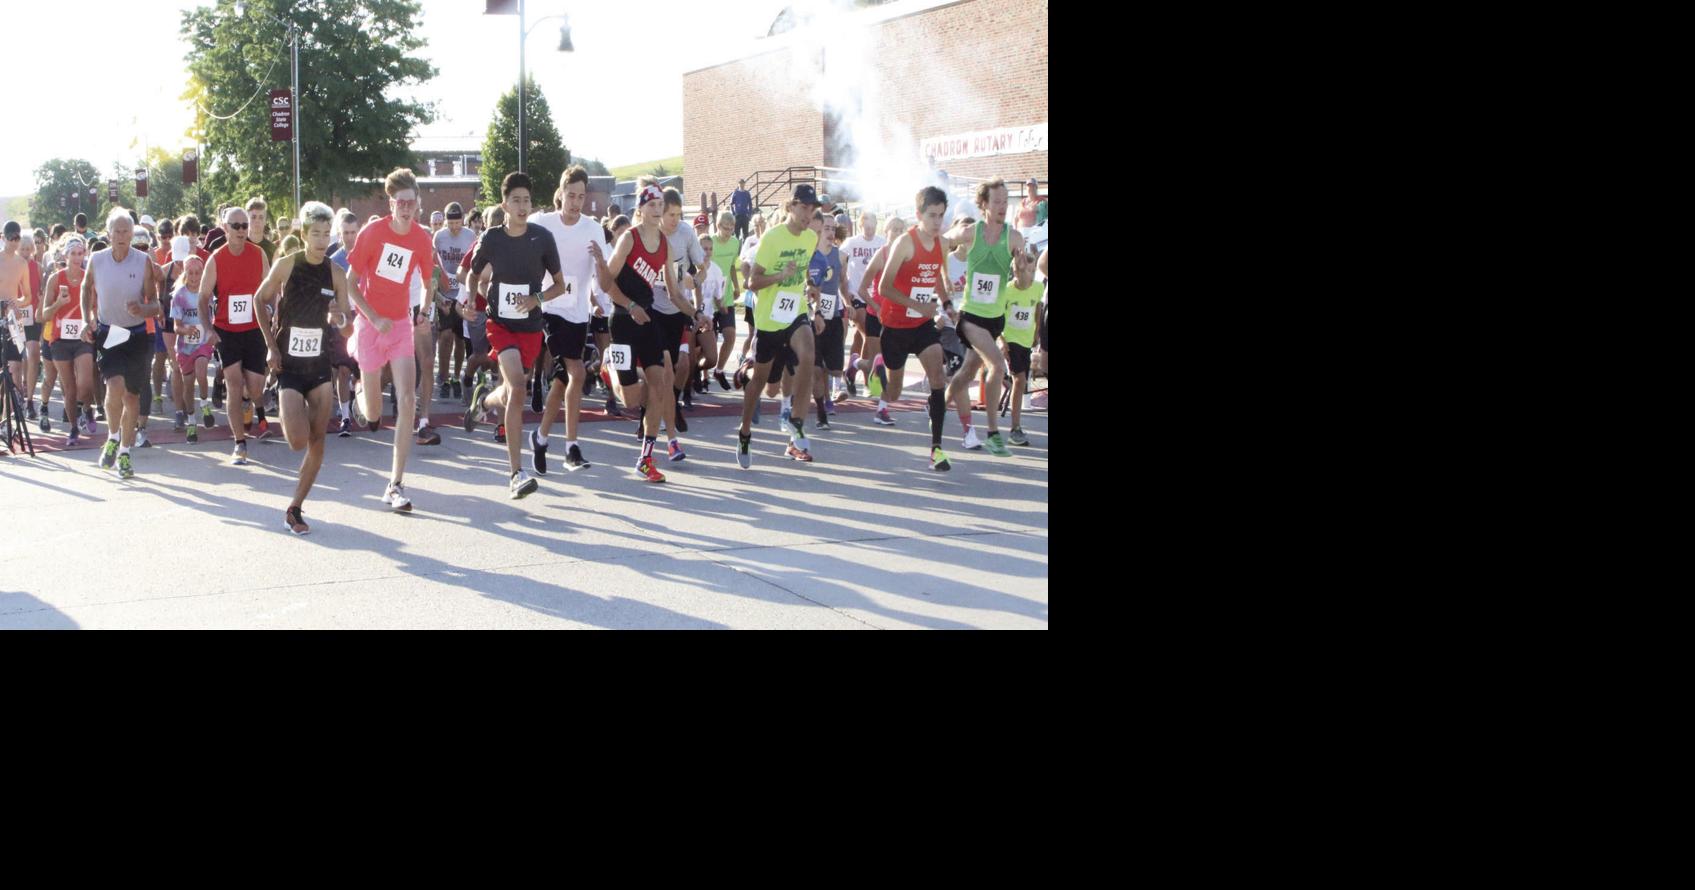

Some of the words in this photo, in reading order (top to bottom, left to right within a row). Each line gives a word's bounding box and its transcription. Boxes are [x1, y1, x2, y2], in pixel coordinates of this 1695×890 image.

[387, 252, 404, 269] 424
[978, 280, 993, 291] 540
[233, 301, 247, 312] 557
[779, 298, 794, 312] 574
[1015, 312, 1029, 321] 438
[65, 324, 79, 335] 529
[291, 337, 319, 353] 2182
